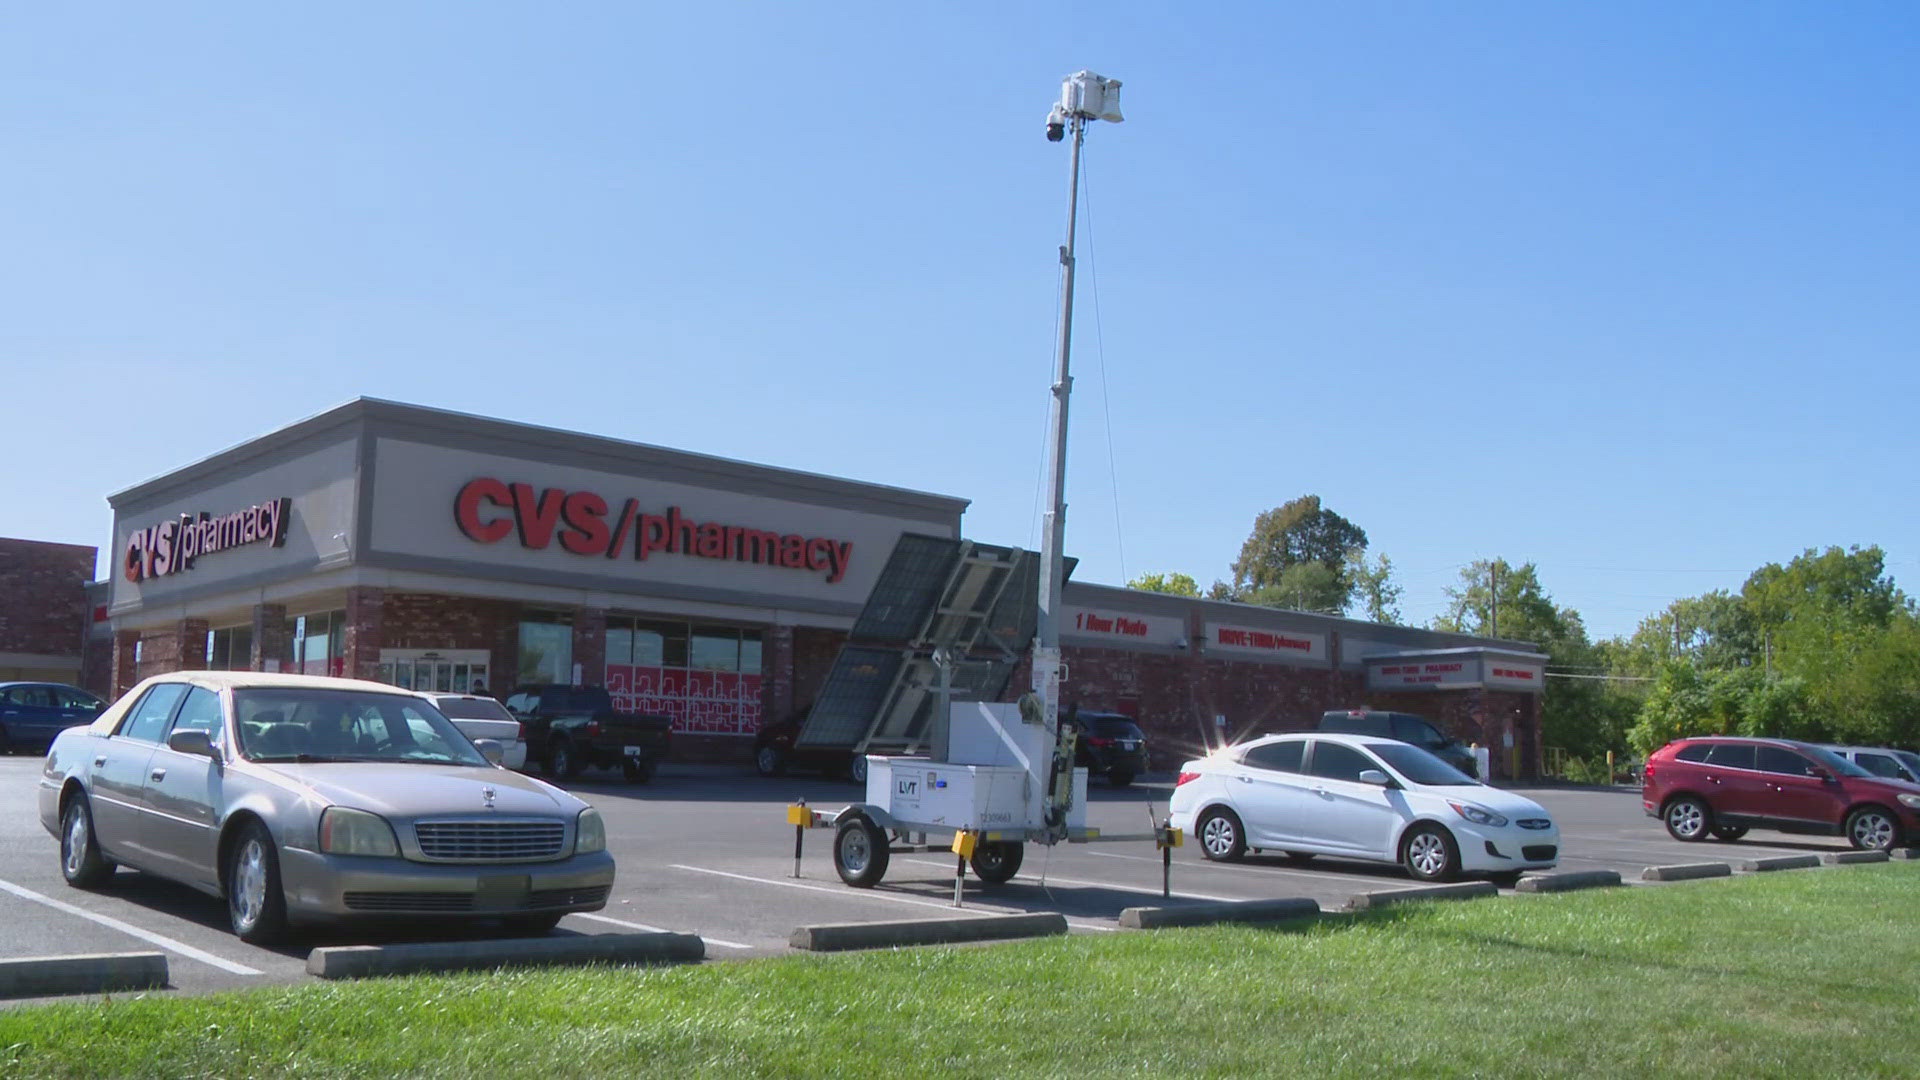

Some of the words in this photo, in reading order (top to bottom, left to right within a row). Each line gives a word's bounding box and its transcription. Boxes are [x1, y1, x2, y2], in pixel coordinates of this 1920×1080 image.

[125, 498, 286, 582] CVS/pharmacy
[454, 477, 853, 583] CVS/pharmacy
[1076, 612, 1082, 630] 1
[1086, 614, 1113, 633] Hour
[1115, 617, 1148, 637] Photo
[899, 781, 917, 795] LVT
